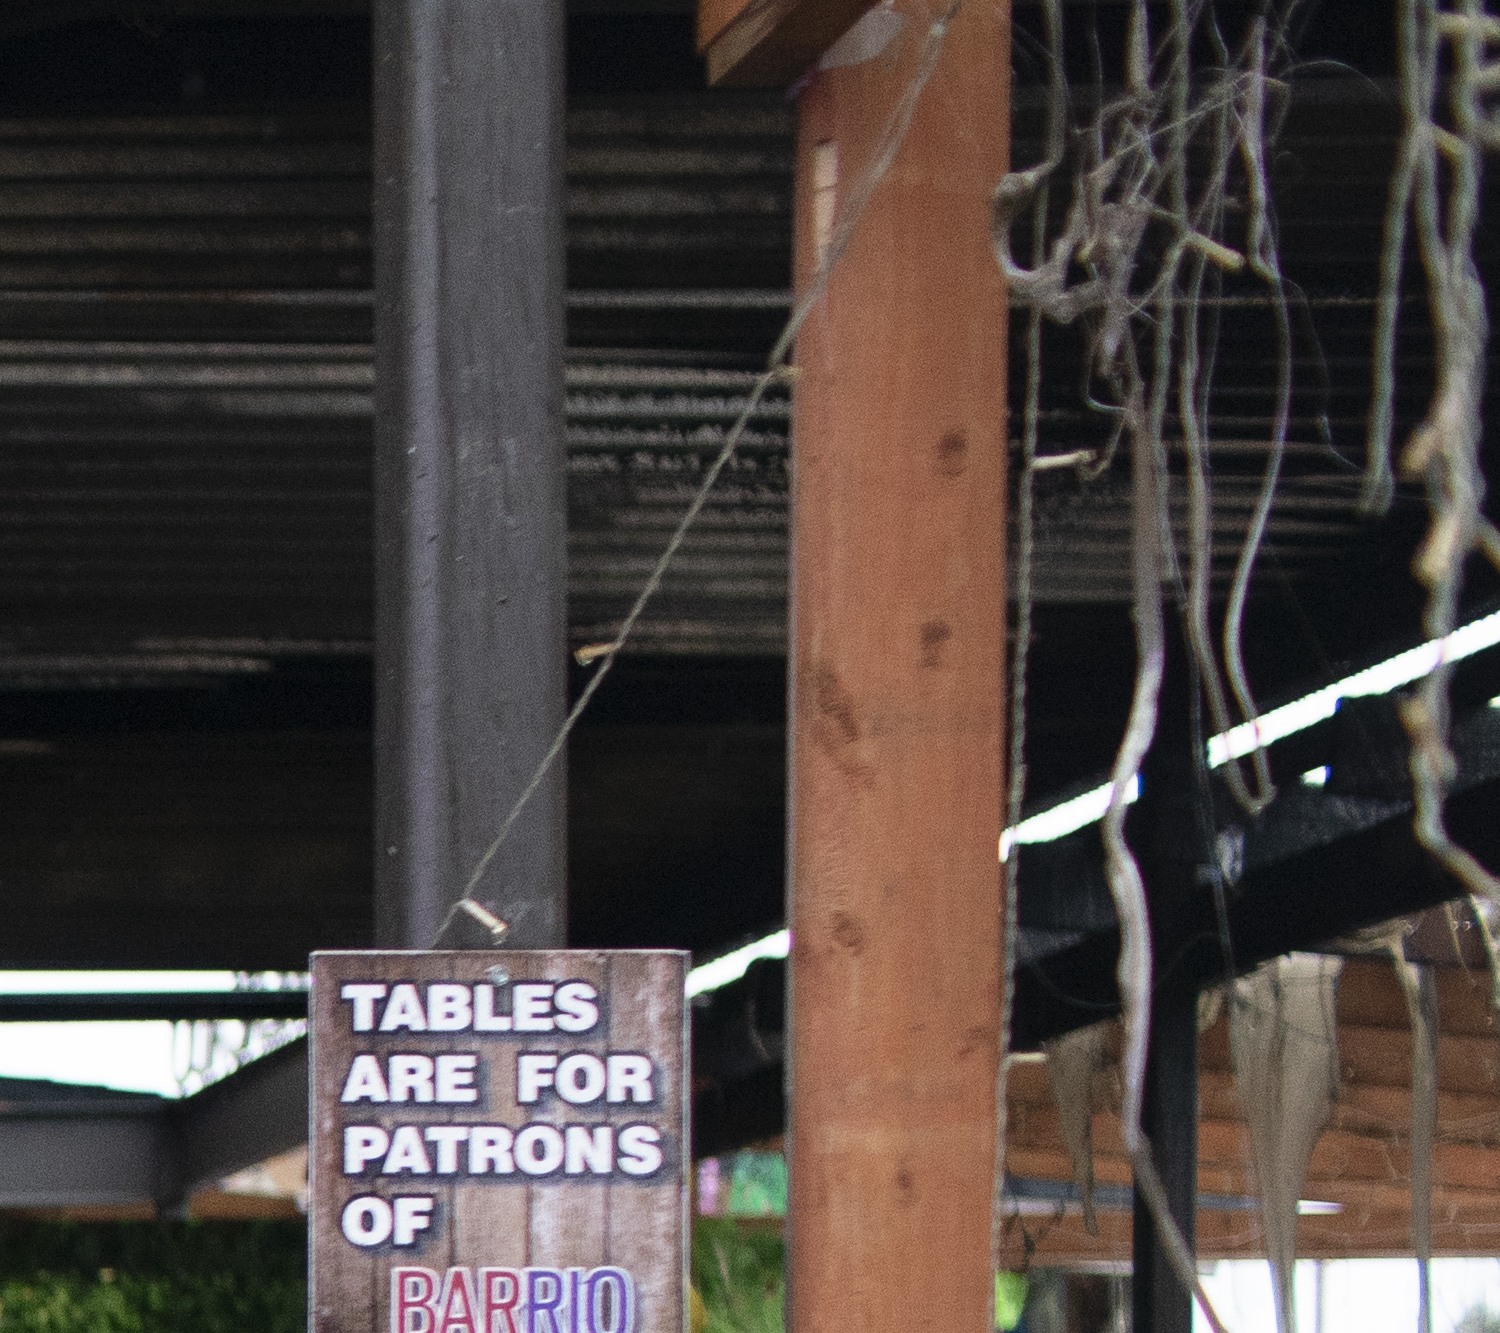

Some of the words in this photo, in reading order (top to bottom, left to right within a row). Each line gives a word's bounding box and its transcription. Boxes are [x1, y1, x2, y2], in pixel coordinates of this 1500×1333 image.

[341, 982, 598, 1032] TABLES
[341, 1054, 478, 1103] ARE
[516, 1054, 653, 1103] FOR
[343, 1125, 663, 1175] PATRONS
[341, 1196, 434, 1245] OF
